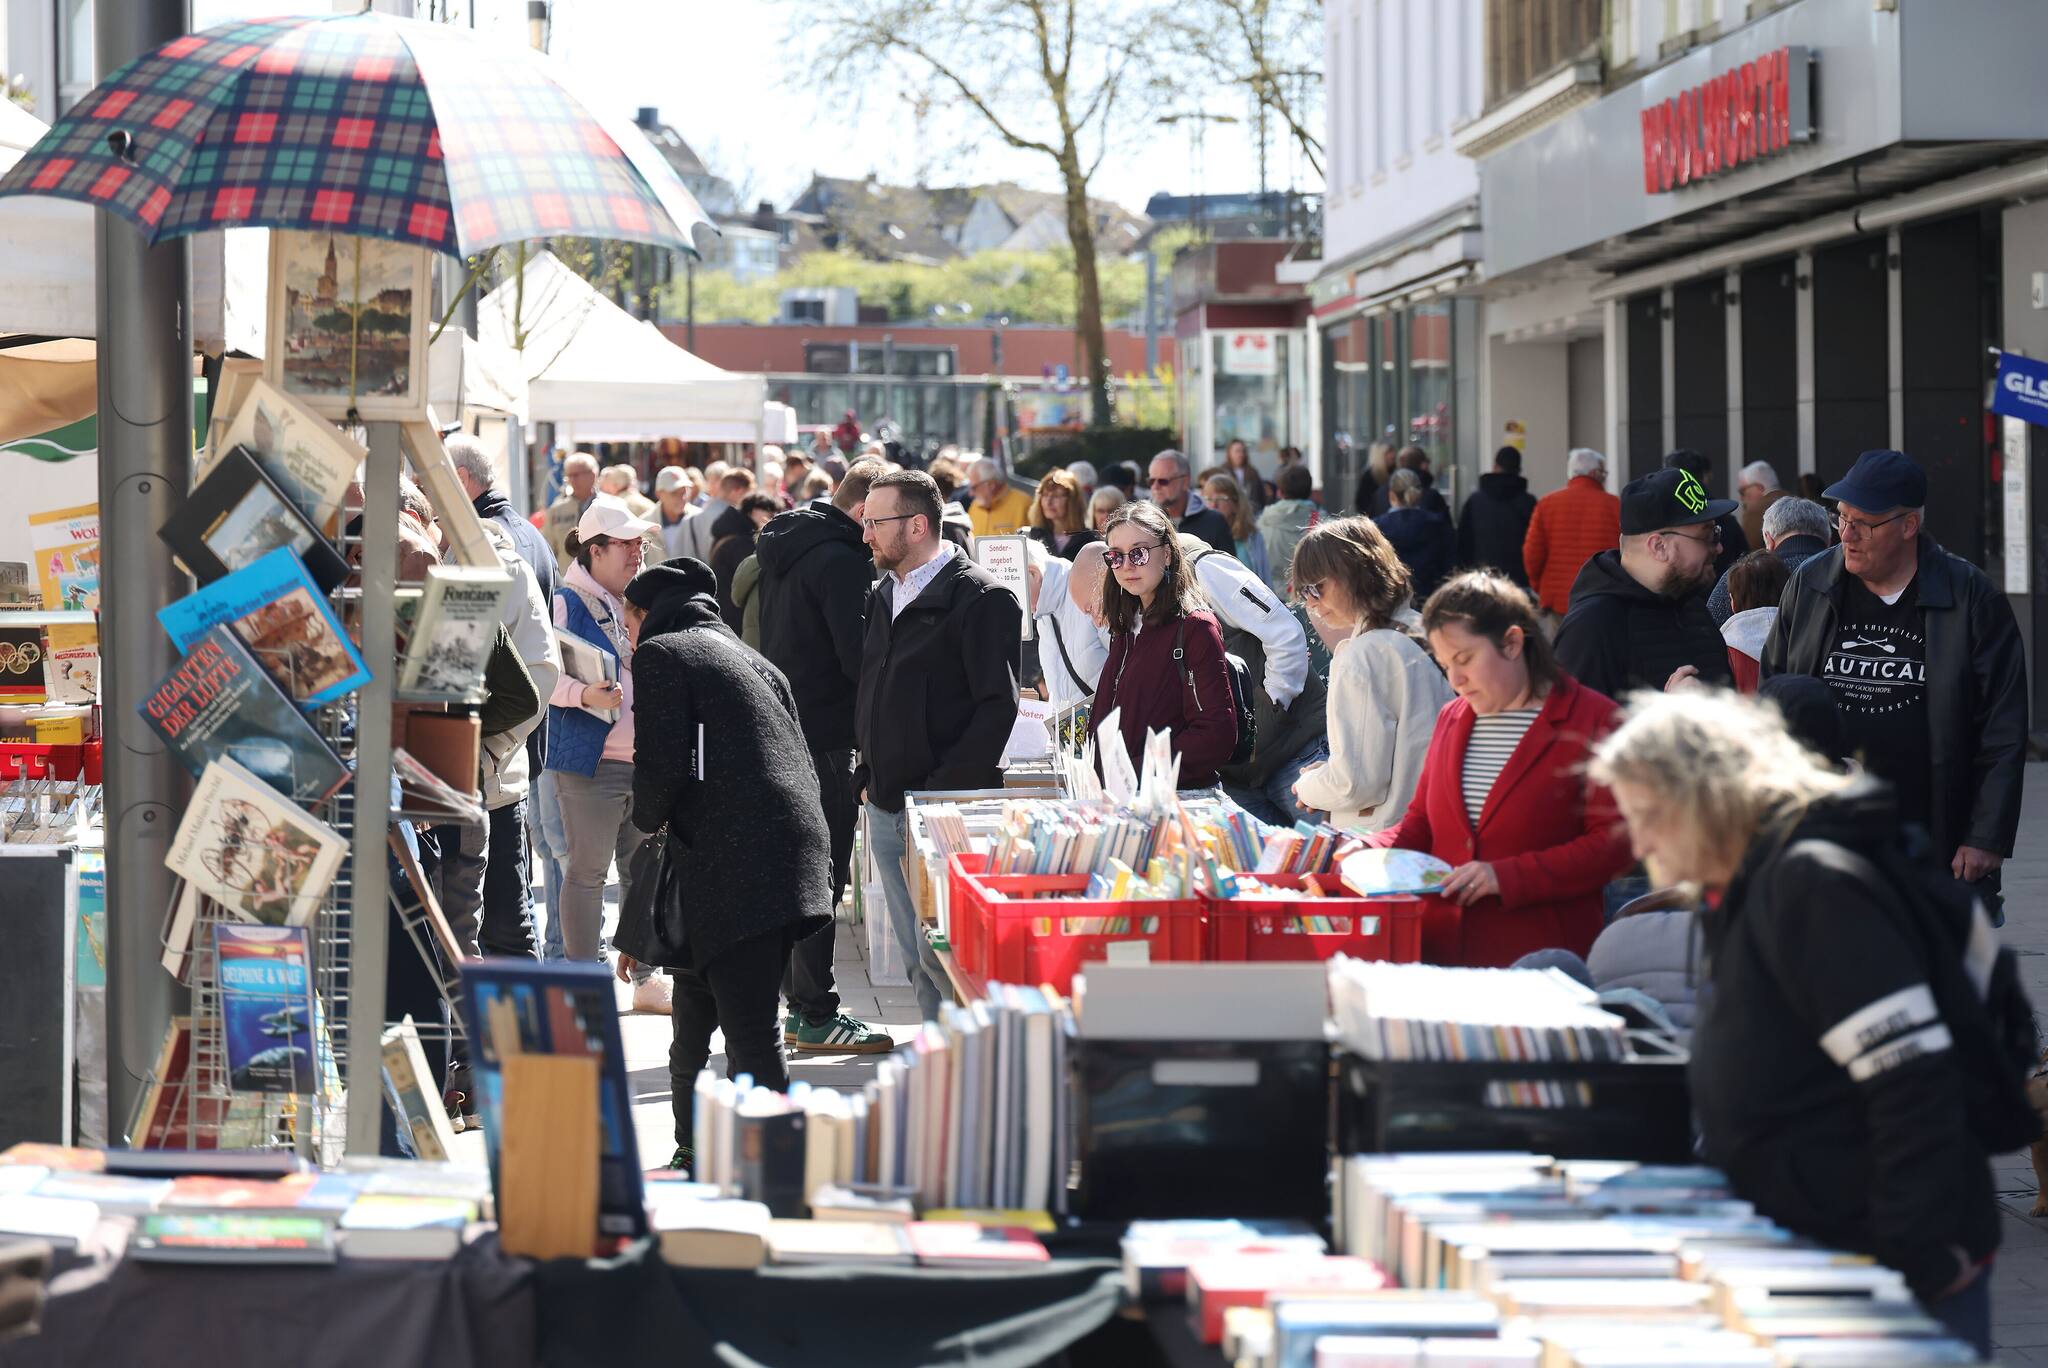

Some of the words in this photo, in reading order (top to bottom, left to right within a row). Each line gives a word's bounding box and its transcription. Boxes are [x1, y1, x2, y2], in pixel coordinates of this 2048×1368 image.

[1640, 44, 1789, 195] WOOLWORTH
[2004, 371, 2048, 400] GLS
[70, 528, 99, 540] WOL
[989, 544, 1012, 552] Sonder-
[990, 557, 1013, 566] angebot
[443, 585, 500, 601] Fontane
[1864, 624, 1924, 645] SHIPBUILDI
[146, 638, 225, 719] GIGANTEN
[1824, 657, 1926, 682] AUTICAL
[160, 700, 199, 738] DER
[190, 655, 241, 709] LÜFTE
[1829, 681, 1845, 689] CAPE
[1855, 684, 1875, 692] GOOD
[1875, 686, 1892, 694] HOPE
[1018, 709, 1045, 720] Noten
[222, 965, 265, 984] DELPHINE
[267, 966, 276, 984] &
